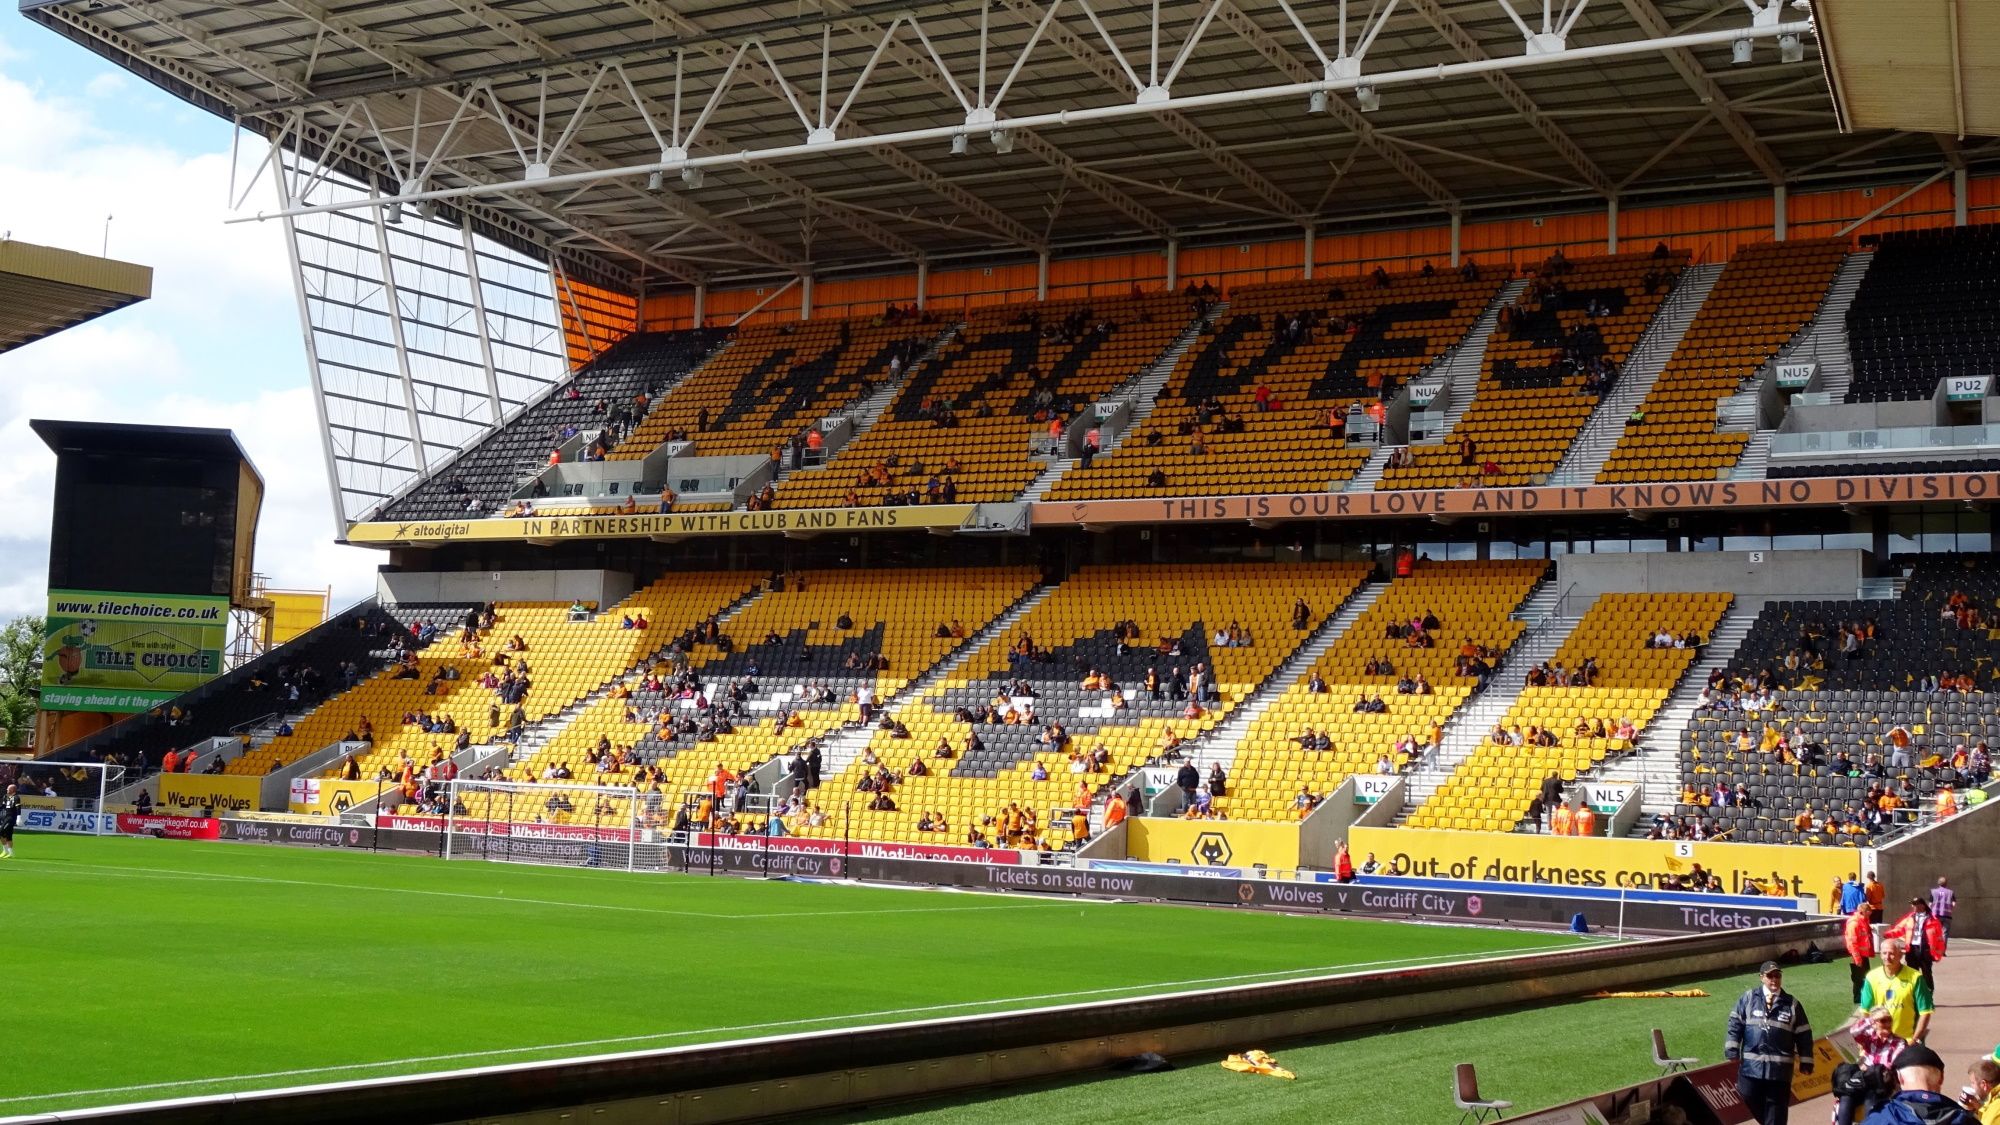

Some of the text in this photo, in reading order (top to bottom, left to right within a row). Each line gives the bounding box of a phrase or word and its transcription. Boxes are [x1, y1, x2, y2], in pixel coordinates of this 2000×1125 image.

[1783, 368, 1809, 378] NU5
[1415, 388, 1438, 398] NU4
[1955, 380, 1981, 391] PU2
[1163, 474, 2000, 518] THIS IS OUR LOVE AND IT KNOWS NO DIVISIO
[414, 523, 470, 539] altodigital
[523, 509, 897, 535] IN PARTNERSHIP WITH CLUB AND FANS
[56, 601, 220, 619] www.tilechoice.co.uk
[95, 651, 210, 669] TILE CHOICE
[44, 692, 82, 706] staying
[85, 693, 116, 705] ahead
[118, 694, 130, 706] of
[132, 695, 149, 706] the
[1365, 781, 1388, 793] PL2
[1596, 789, 1624, 802] NL5
[168, 791, 251, 810] We are Wolves
[236, 823, 344, 844] Wolves v Cardiff City
[511, 825, 620, 841] WhatHousecouk
[718, 836, 841, 854] WhatHousecouk
[861, 844, 994, 864] WhatHousecouk
[682, 849, 822, 875] Wolves v Cardiff City
[1394, 853, 1439, 877] Out
[1450, 856, 1478, 879] of
[1485, 858, 1607, 887] darkness
[986, 866, 1134, 891] Tickets on sale now
[1268, 885, 1455, 915] Wolves v Cardiff City
[1680, 907, 1751, 929] Tickets
